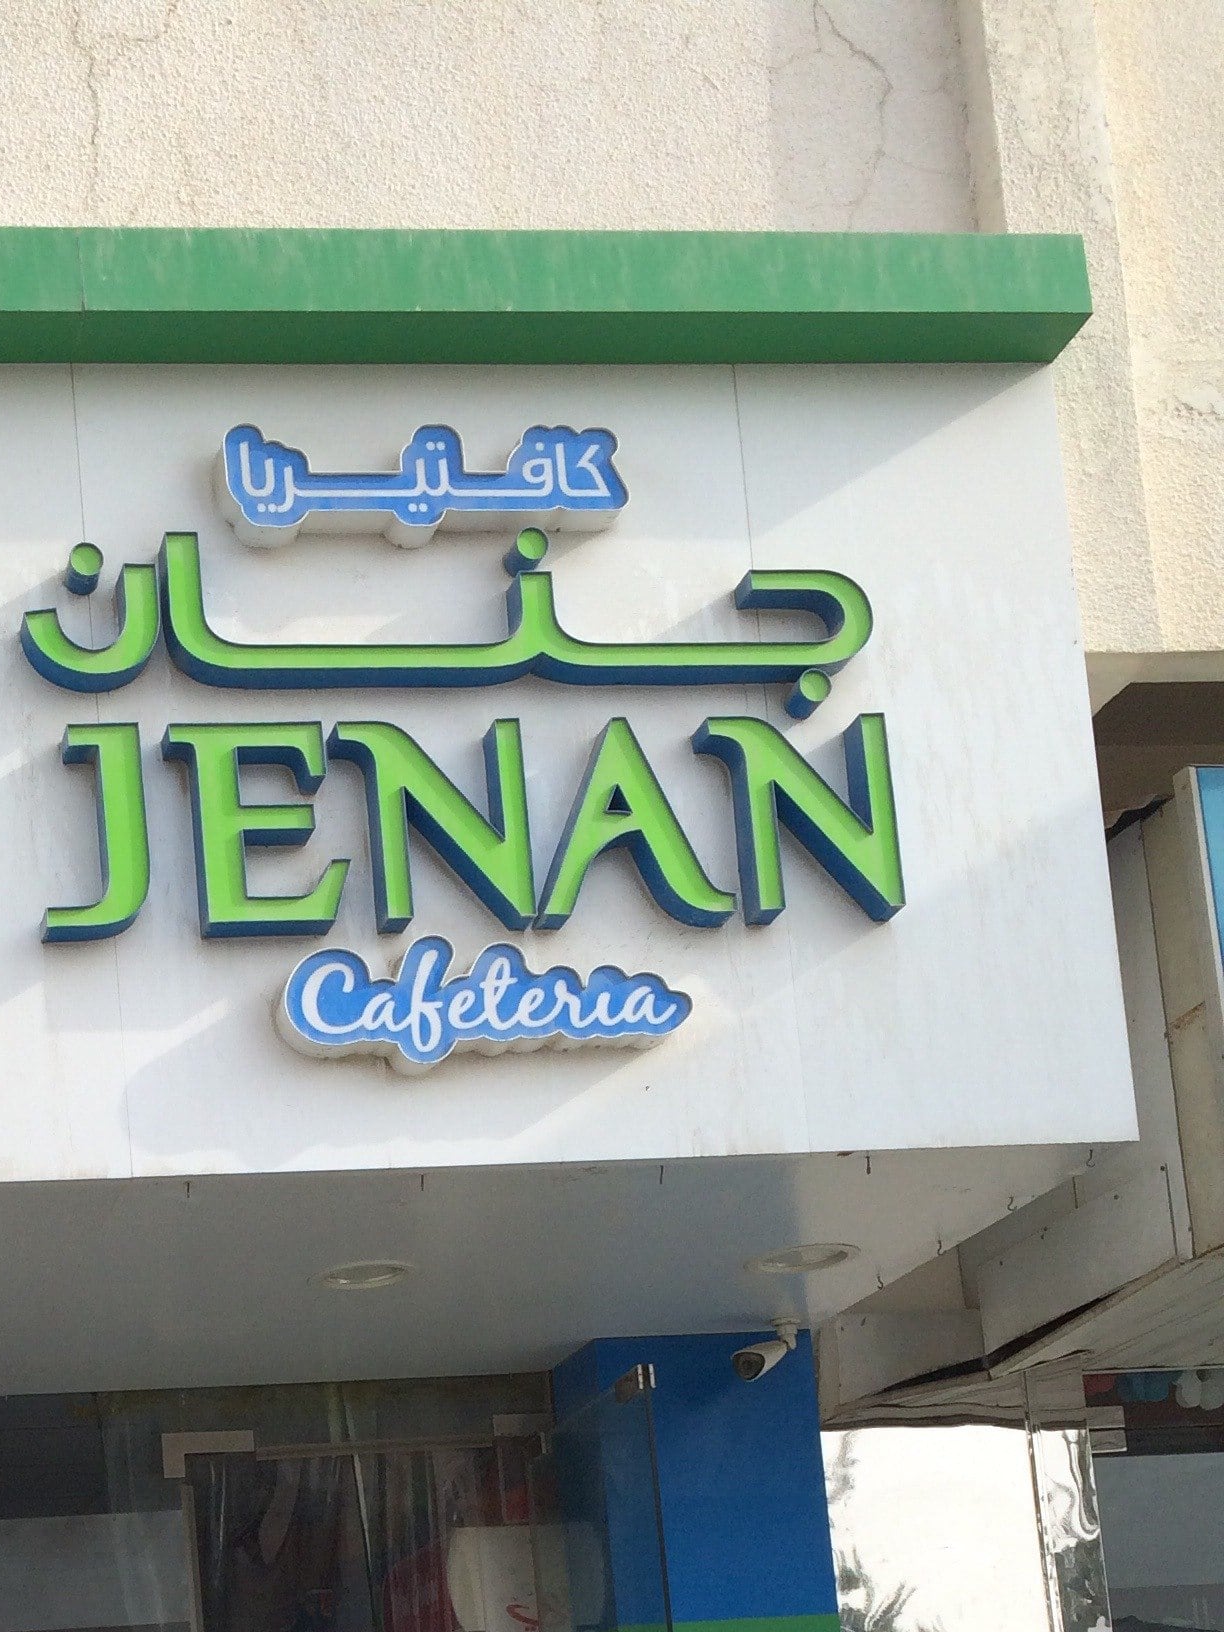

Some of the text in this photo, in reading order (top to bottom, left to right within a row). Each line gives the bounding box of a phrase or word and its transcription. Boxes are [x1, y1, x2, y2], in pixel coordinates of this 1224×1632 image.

[20, 527, 873, 720] جنان
[41, 713, 906, 942] JENAN
[302, 949, 676, 1053] Cafeteria
